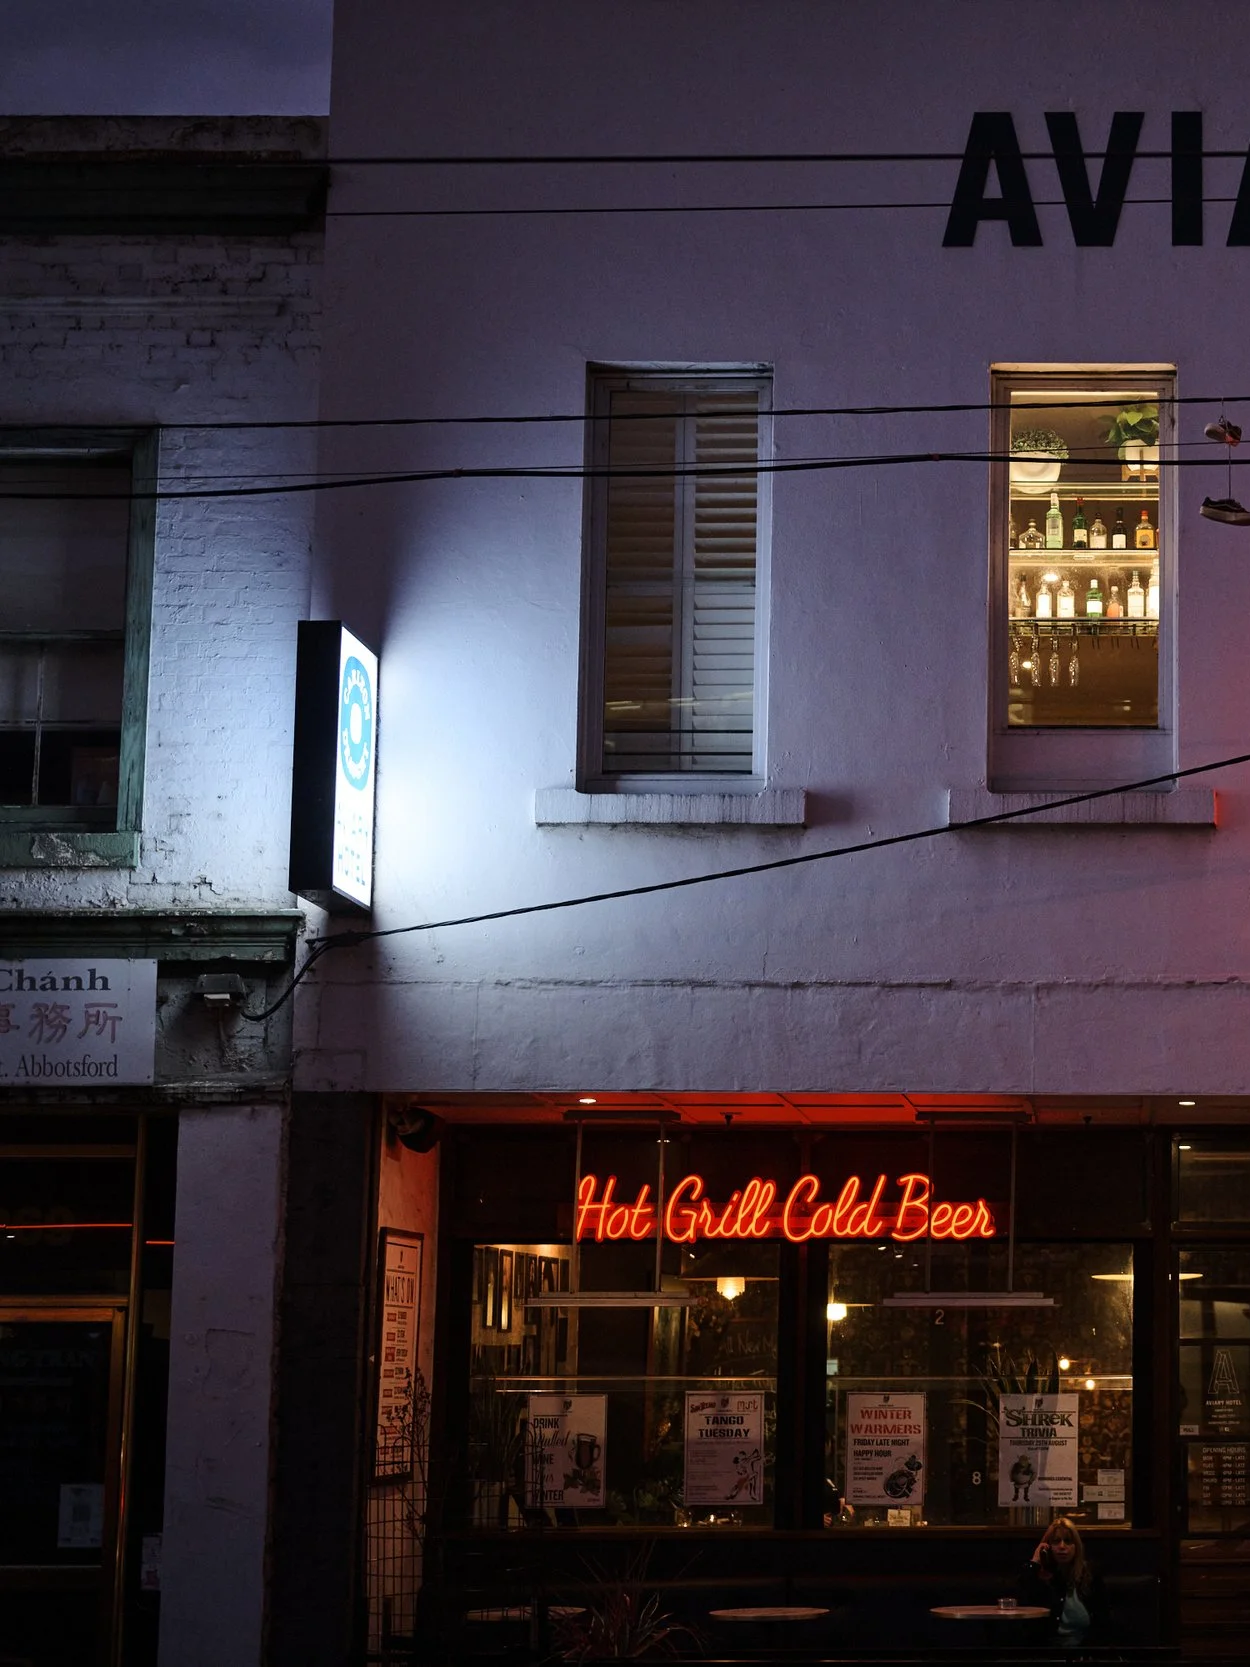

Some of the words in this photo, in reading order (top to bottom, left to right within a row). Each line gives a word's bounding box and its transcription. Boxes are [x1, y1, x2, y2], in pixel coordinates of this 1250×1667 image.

[15, 1054, 119, 1078] Abbotsford
[576, 1173, 652, 1244] Hot
[664, 1174, 777, 1244] Grill
[783, 1173, 886, 1242] Cold
[892, 1173, 997, 1243] Beer
[935, 1309, 945, 1325] 2
[861, 1409, 912, 1420] WINTER
[534, 1418, 560, 1429] DRINK
[705, 1416, 744, 1425] TANGO
[698, 1428, 751, 1438] TUESDAY
[850, 1424, 922, 1435] WARMERS
[1021, 1428, 1057, 1437] TRIVIA
[972, 1471, 982, 1485] 8
